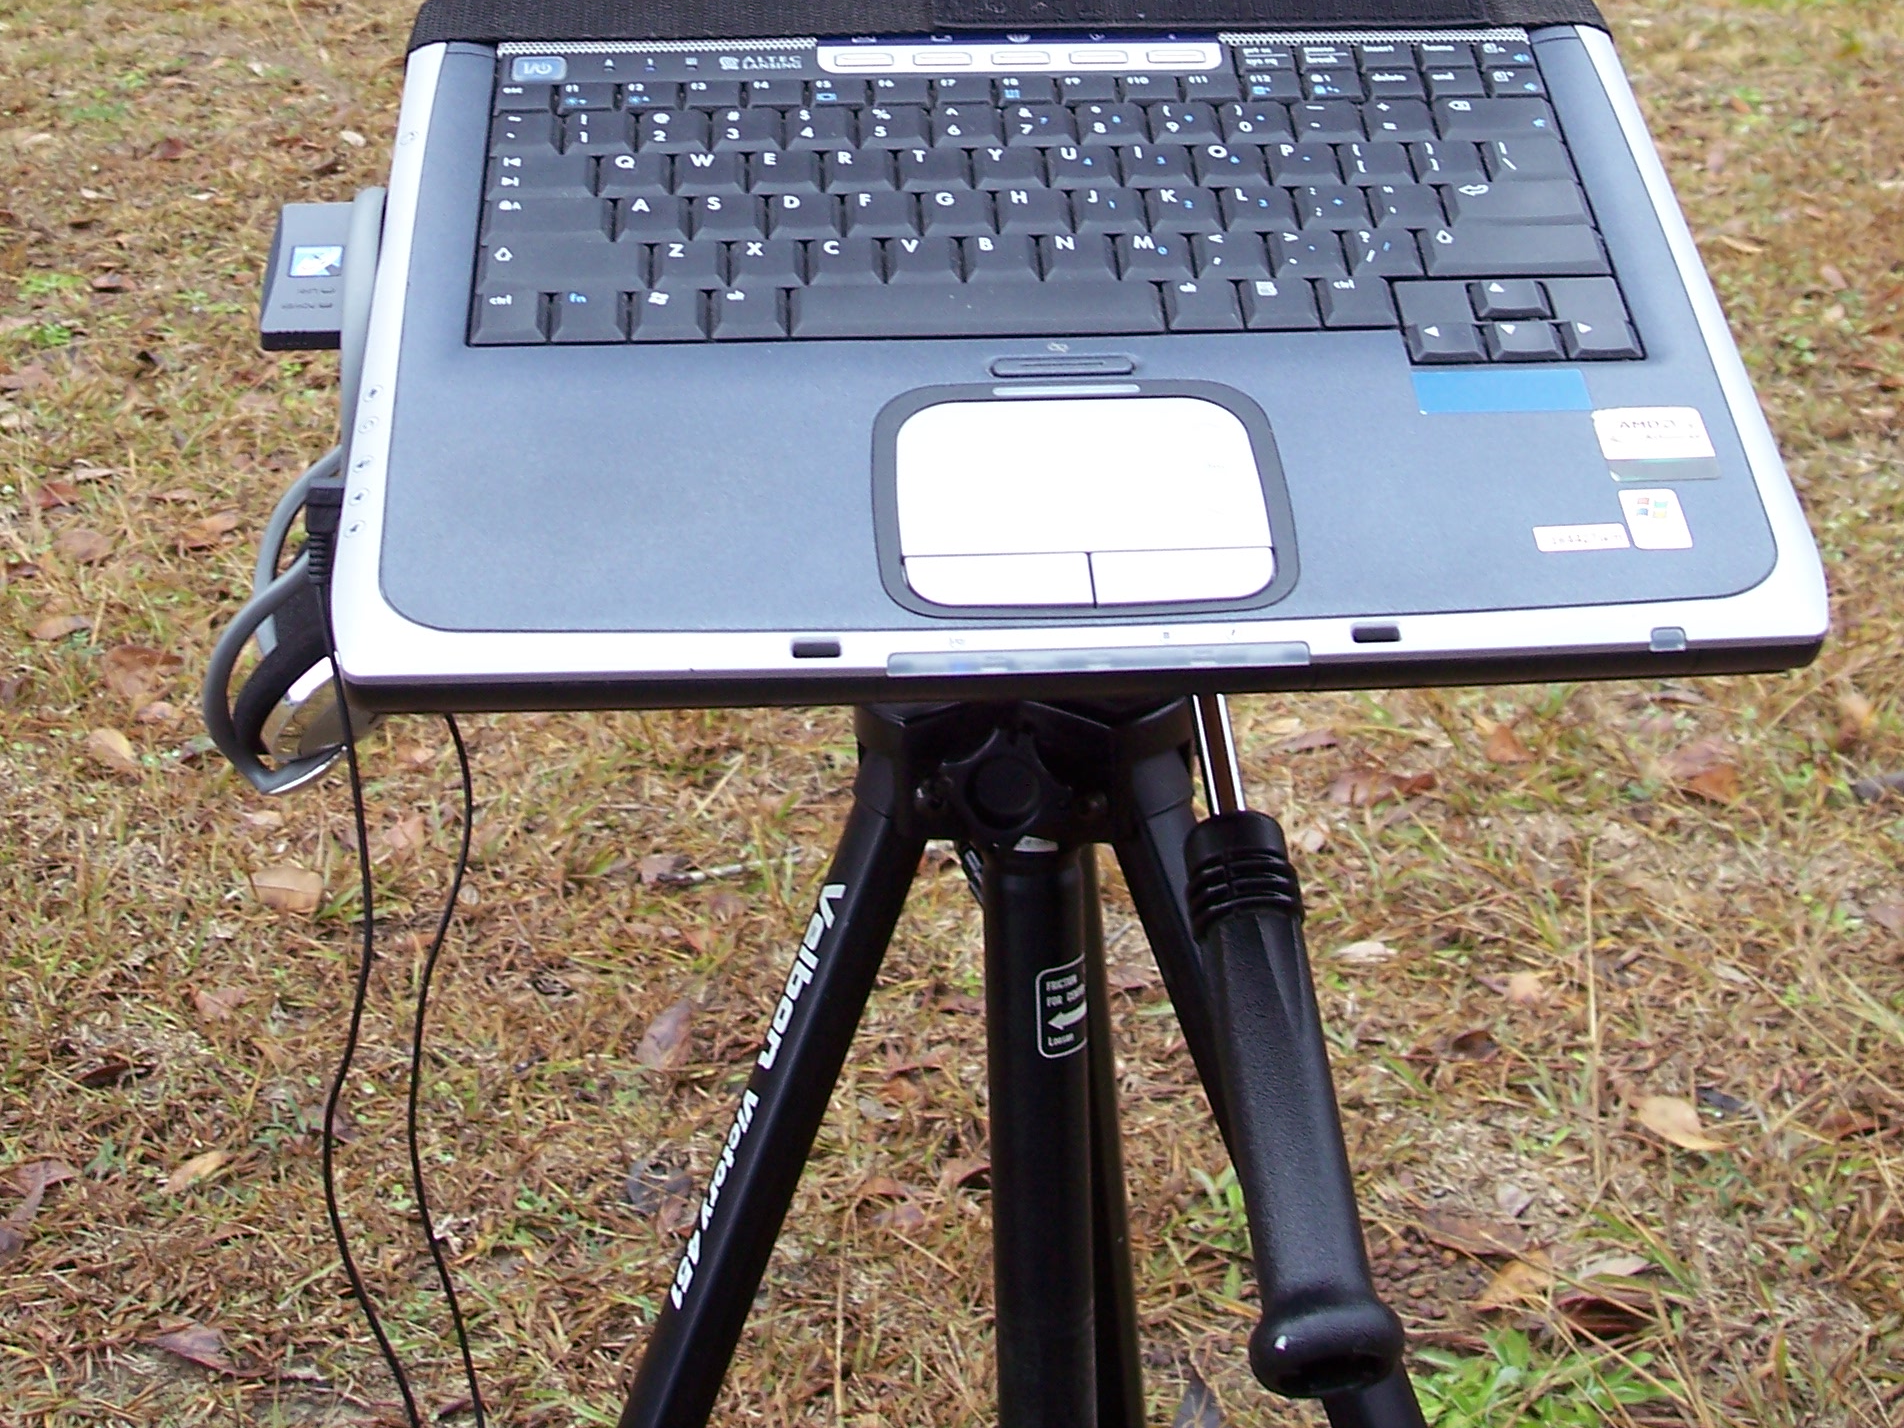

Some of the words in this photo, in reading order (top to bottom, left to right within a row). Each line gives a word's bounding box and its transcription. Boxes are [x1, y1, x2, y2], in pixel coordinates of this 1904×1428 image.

[726, 127, 740, 140] 3
[800, 126, 814, 138] 4
[874, 125, 887, 138] 5
[947, 124, 962, 136] 6
[1019, 123, 1033, 135] 7
[1093, 121, 1107, 134] 8
[1165, 121, 1180, 133] 9
[1238, 121, 1253, 133] 0
[579, 131, 588, 143] 1
[653, 130, 666, 142] 2
[912, 149, 926, 163] T
[987, 148, 1003, 162] Y
[1060, 147, 1078, 160] U
[1207, 145, 1228, 158] O
[1279, 144, 1294, 157] P
[614, 155, 636, 169] Q
[689, 153, 715, 167] W
[763, 152, 777, 166] E
[837, 151, 853, 165] R
[858, 193, 872, 207] F
[935, 192, 955, 206] G
[1010, 190, 1028, 205] H
[1087, 189, 1098, 203] J
[1159, 189, 1178, 203] K
[1234, 187, 1249, 202] L
[631, 198, 650, 212] A
[707, 196, 722, 211] S
[783, 195, 801, 209] D
[746, 241, 764, 257] X
[823, 240, 840, 255] C
[900, 238, 919, 253] V
[978, 236, 994, 251] B
[1054, 235, 1075, 251] N
[1133, 235, 1155, 250] M
[668, 243, 685, 258] Z
[757, 884, 846, 1070] Velbon
[700, 1088, 760, 1231] Victory
